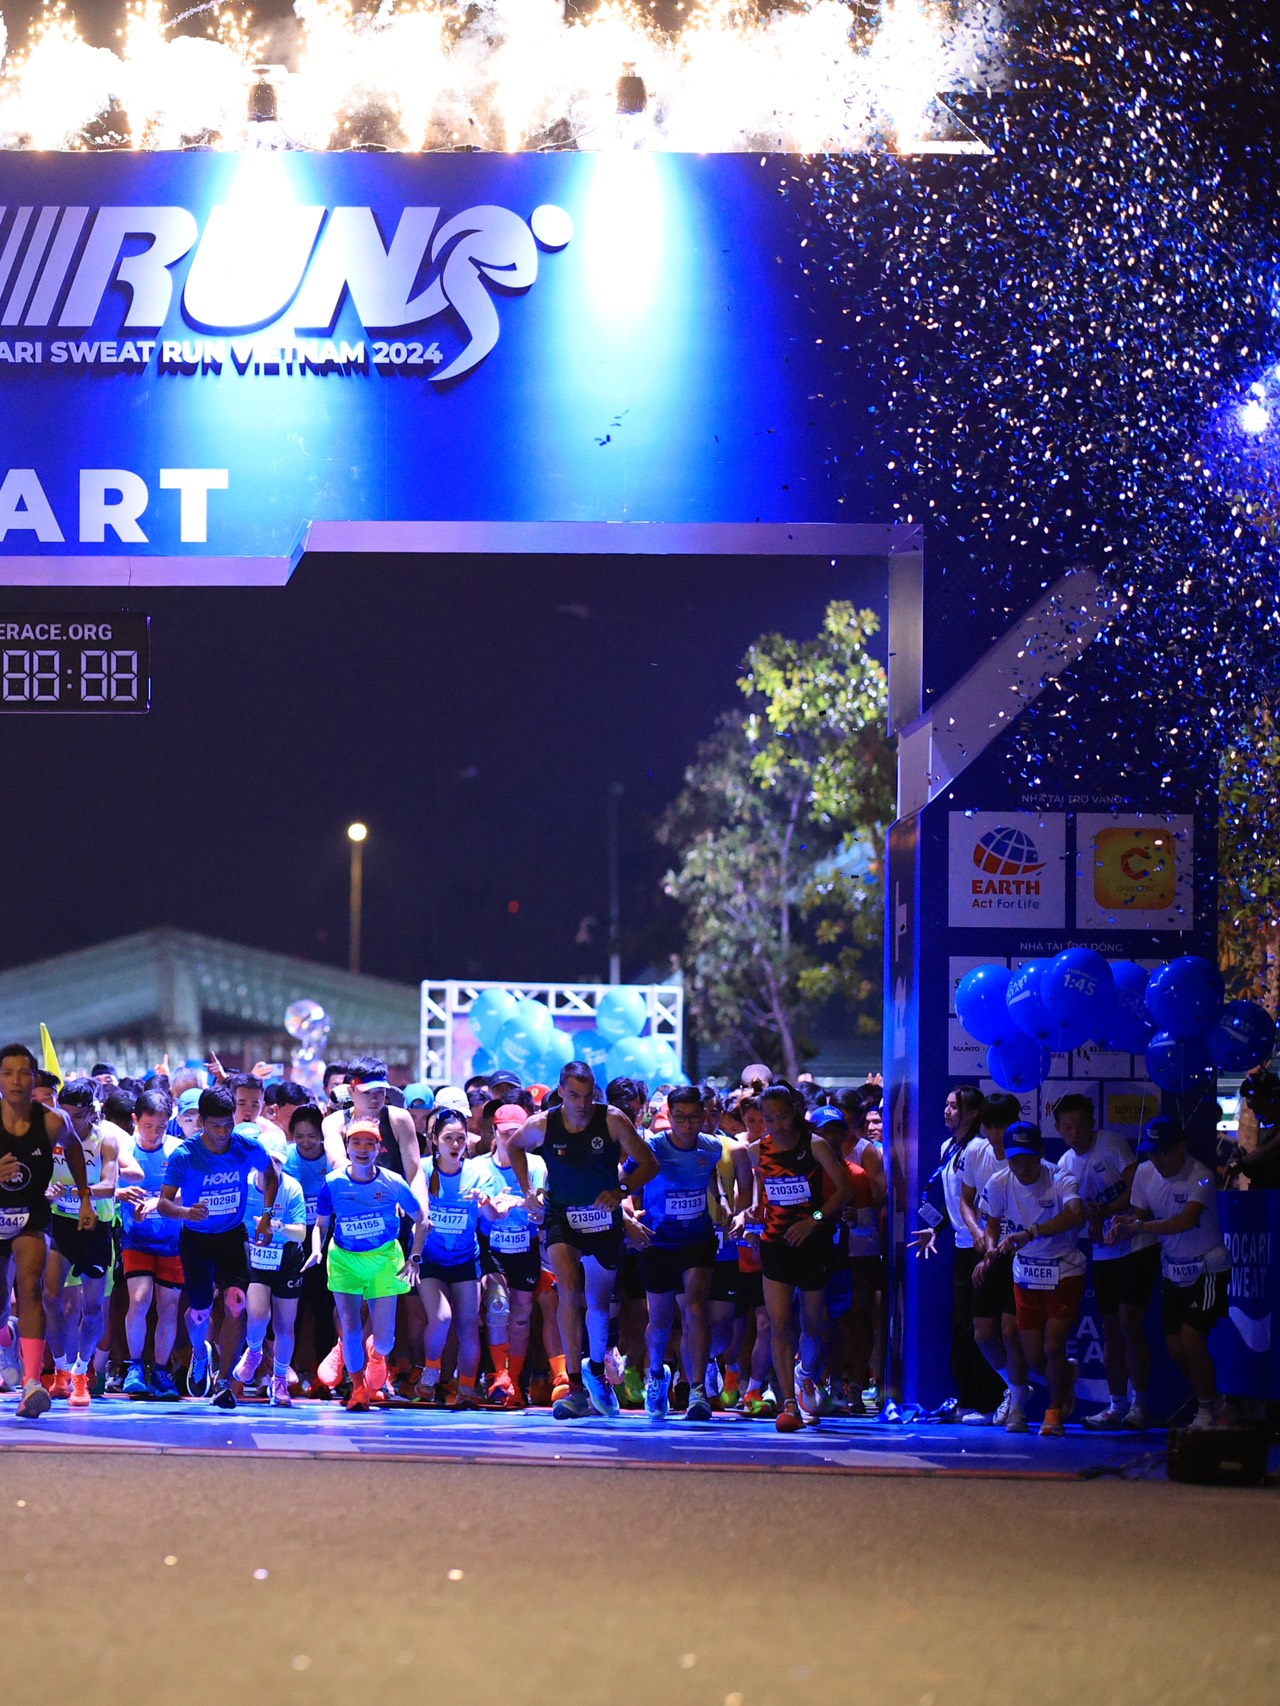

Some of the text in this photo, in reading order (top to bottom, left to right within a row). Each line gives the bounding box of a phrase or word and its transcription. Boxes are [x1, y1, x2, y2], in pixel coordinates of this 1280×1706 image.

[50, 340, 156, 364] SWEAT
[162, 340, 223, 364] RUN
[230, 340, 365, 365] VIETNAM
[372, 341, 444, 364] 2024
[972, 879, 1040, 895] EARTH
[972, 898, 1040, 909] Act For Life
[1063, 974, 1097, 996] 1:45
[203, 1171, 240, 1186] HOKA
[770, 1184, 805, 1195] 210353
[670, 1198, 702, 1209] 213133
[431, 1213, 463, 1224] 214177
[571, 1211, 607, 1223] 213500
[346, 1220, 379, 1231] 214155
[1023, 1266, 1053, 1278] PACER
[1227, 1266, 1268, 1298] WEAT
